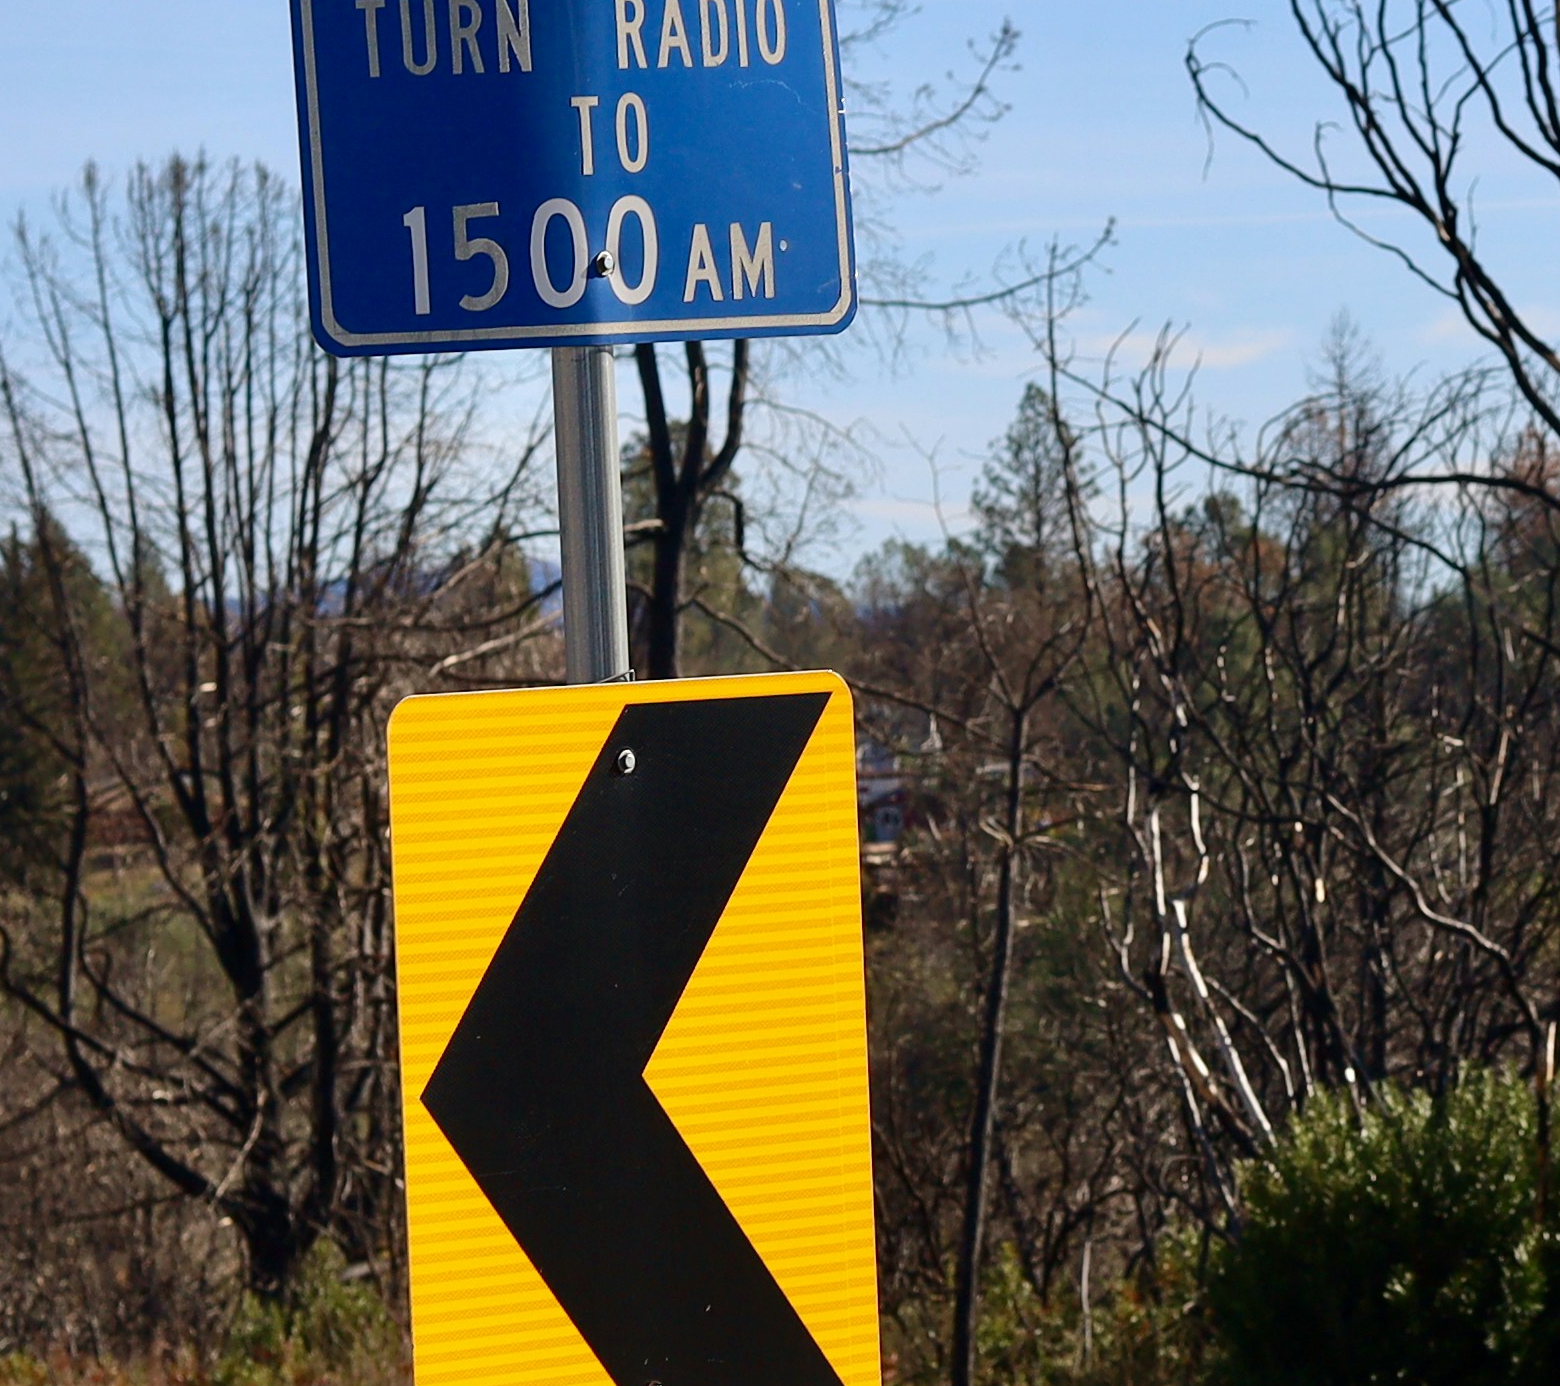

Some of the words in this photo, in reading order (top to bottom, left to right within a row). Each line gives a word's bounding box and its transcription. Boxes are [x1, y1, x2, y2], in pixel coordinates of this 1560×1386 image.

[571, 92, 649, 176] TO
[403, 195, 658, 315] 1500
[683, 221, 775, 302] AM
